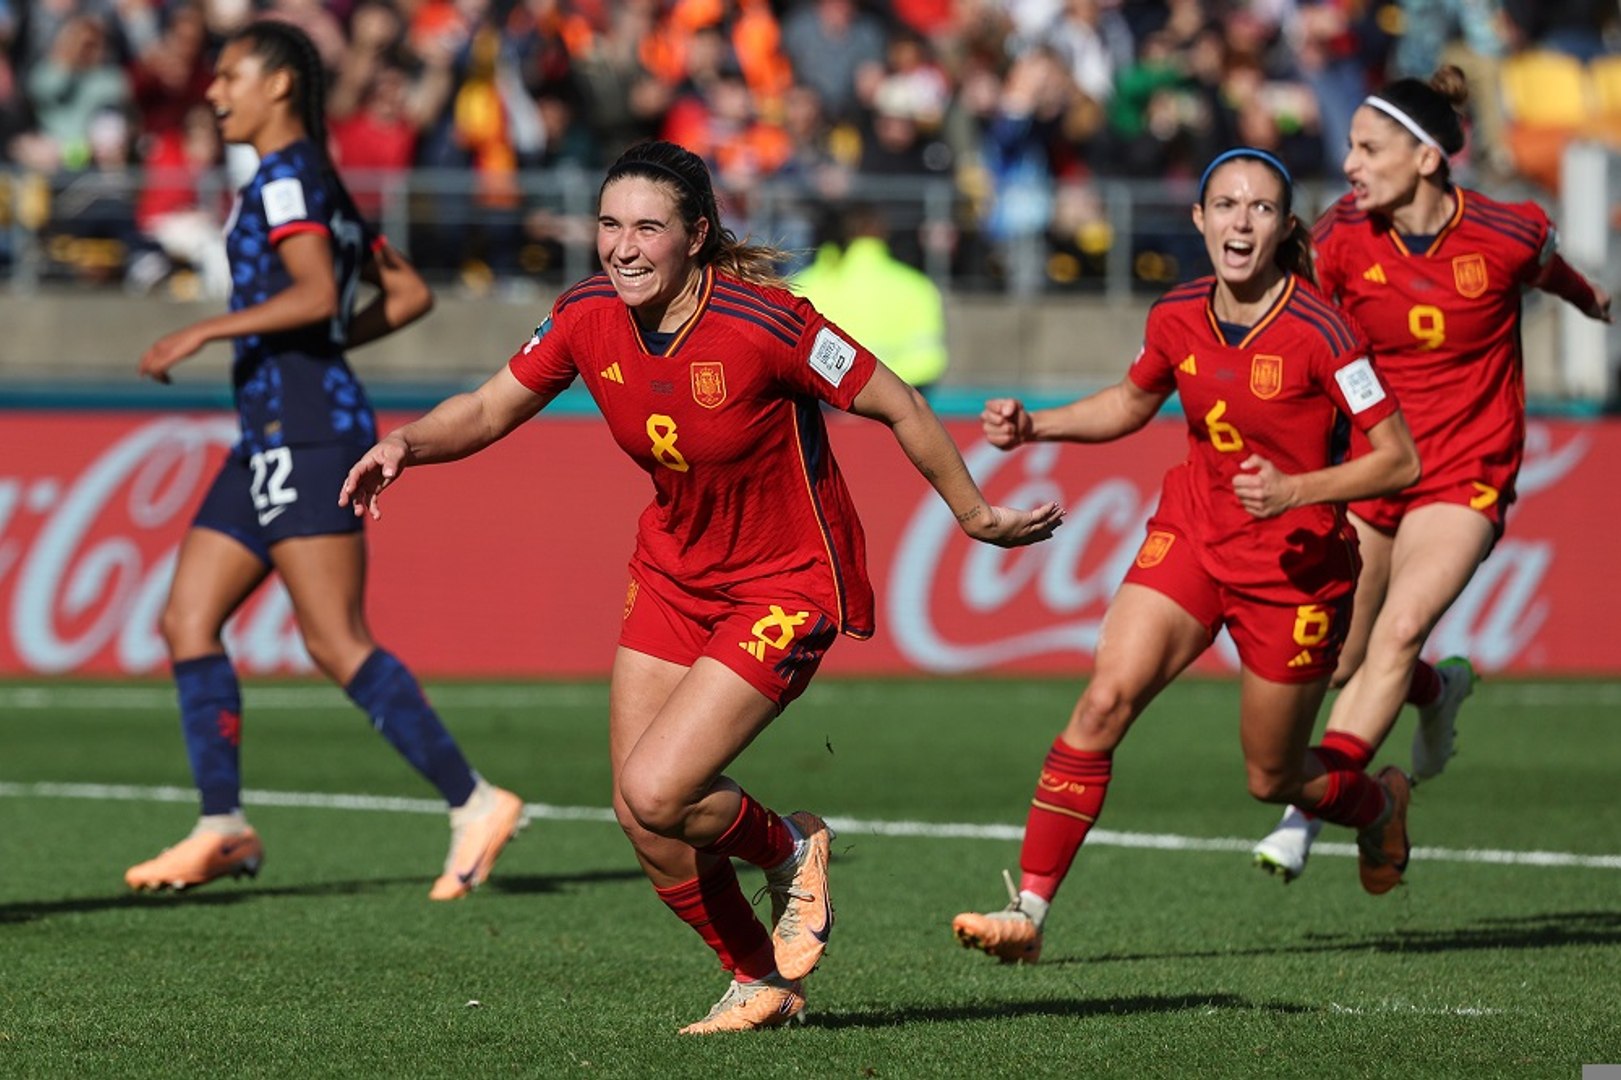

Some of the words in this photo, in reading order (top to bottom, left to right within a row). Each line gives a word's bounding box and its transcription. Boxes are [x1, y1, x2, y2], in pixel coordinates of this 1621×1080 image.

[1408, 304, 1445, 350] 9
[646, 413, 689, 472] 8
[1205, 400, 1243, 452] 6
[249, 446, 298, 510] 22
[1293, 604, 1329, 646] 6
